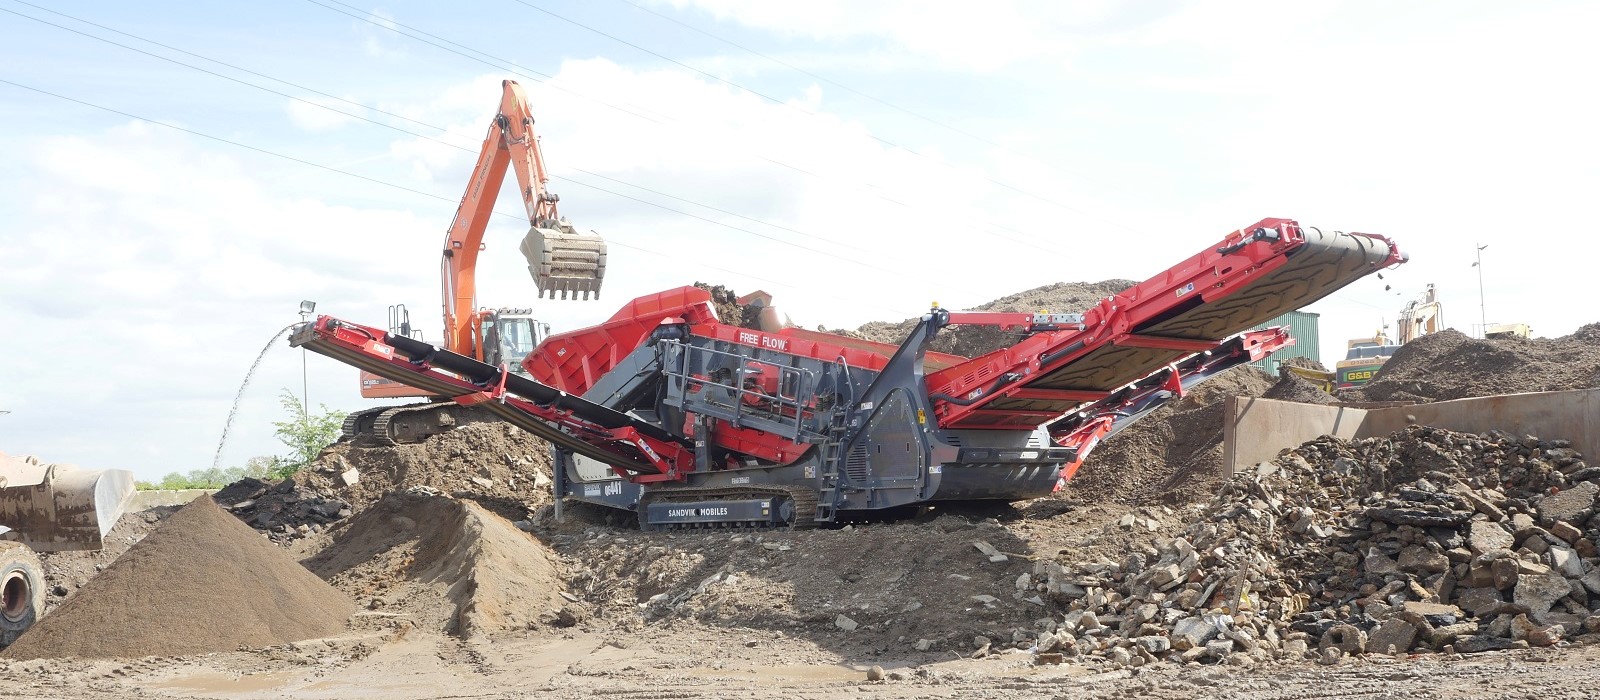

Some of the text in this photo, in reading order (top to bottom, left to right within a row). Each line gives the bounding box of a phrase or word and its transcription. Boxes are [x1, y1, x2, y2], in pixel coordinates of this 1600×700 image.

[740, 332, 786, 350] FREE FLOW
[1347, 371, 1371, 380] G&B
[668, 508, 728, 517] SANDVIK MOBILES
